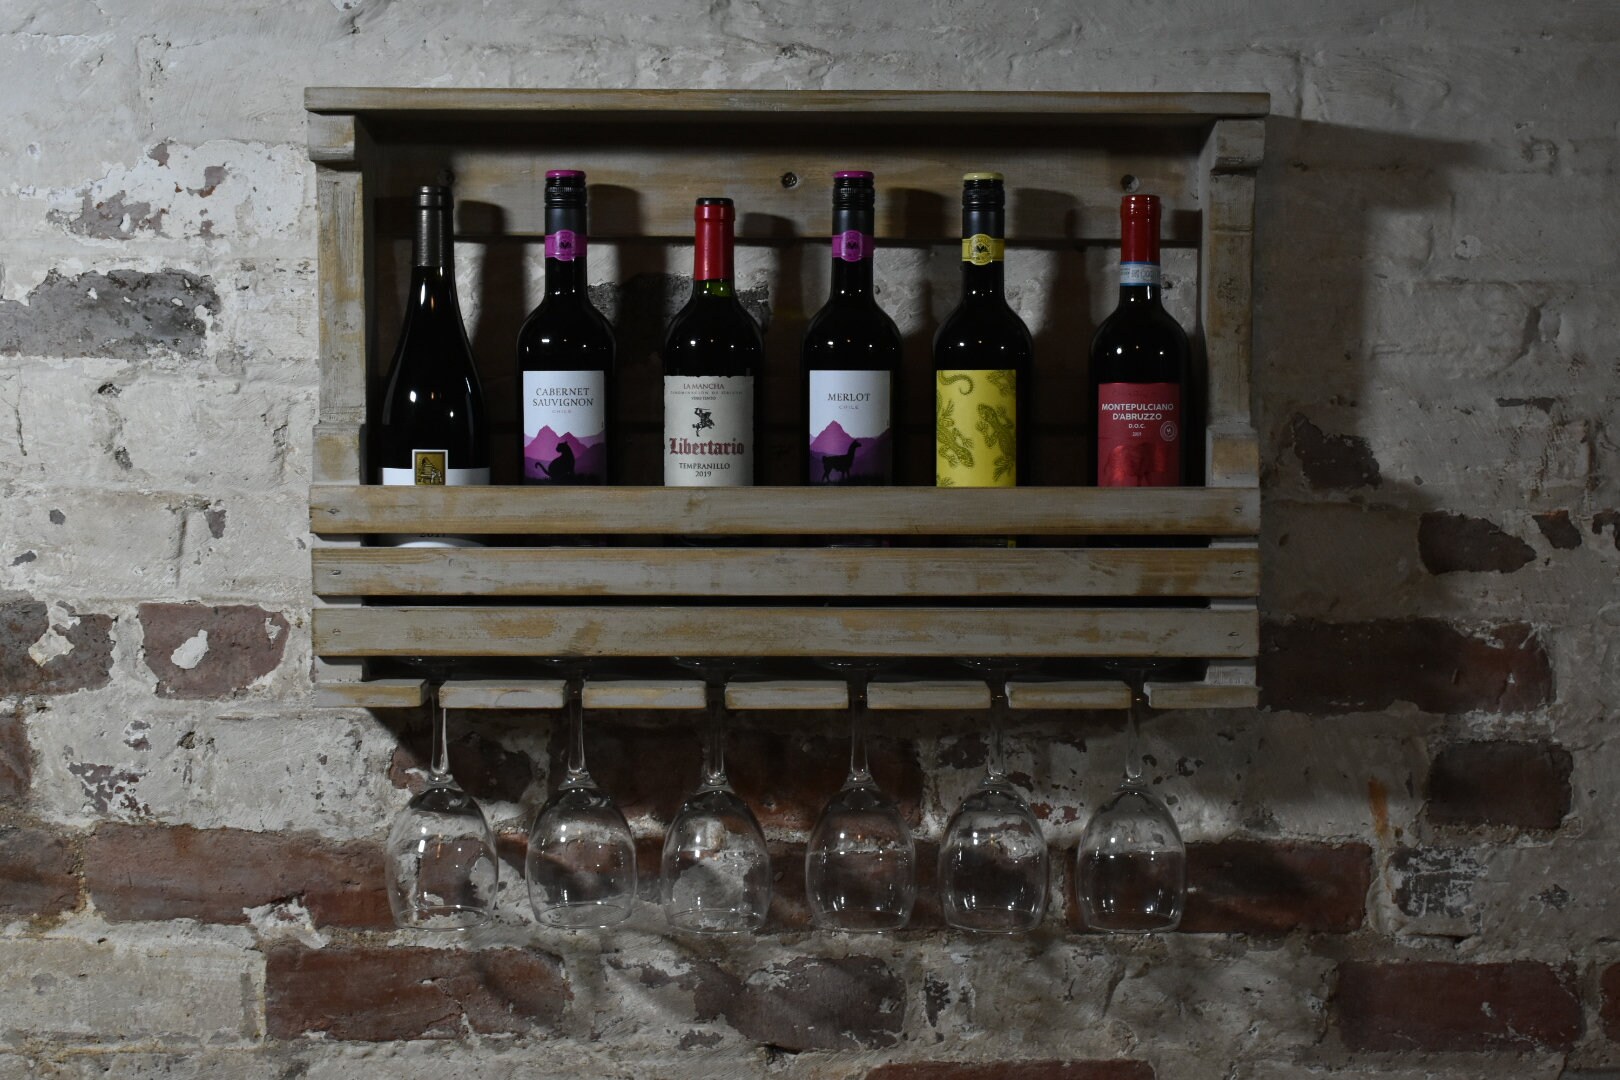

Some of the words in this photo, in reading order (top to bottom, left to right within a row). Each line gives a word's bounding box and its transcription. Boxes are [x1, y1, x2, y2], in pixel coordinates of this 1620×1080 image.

[536, 388, 590, 396] CABERNET
[828, 393, 870, 401] MERLOT
[532, 398, 594, 406] SAUVIGNON
[669, 438, 744, 455] Libertario
